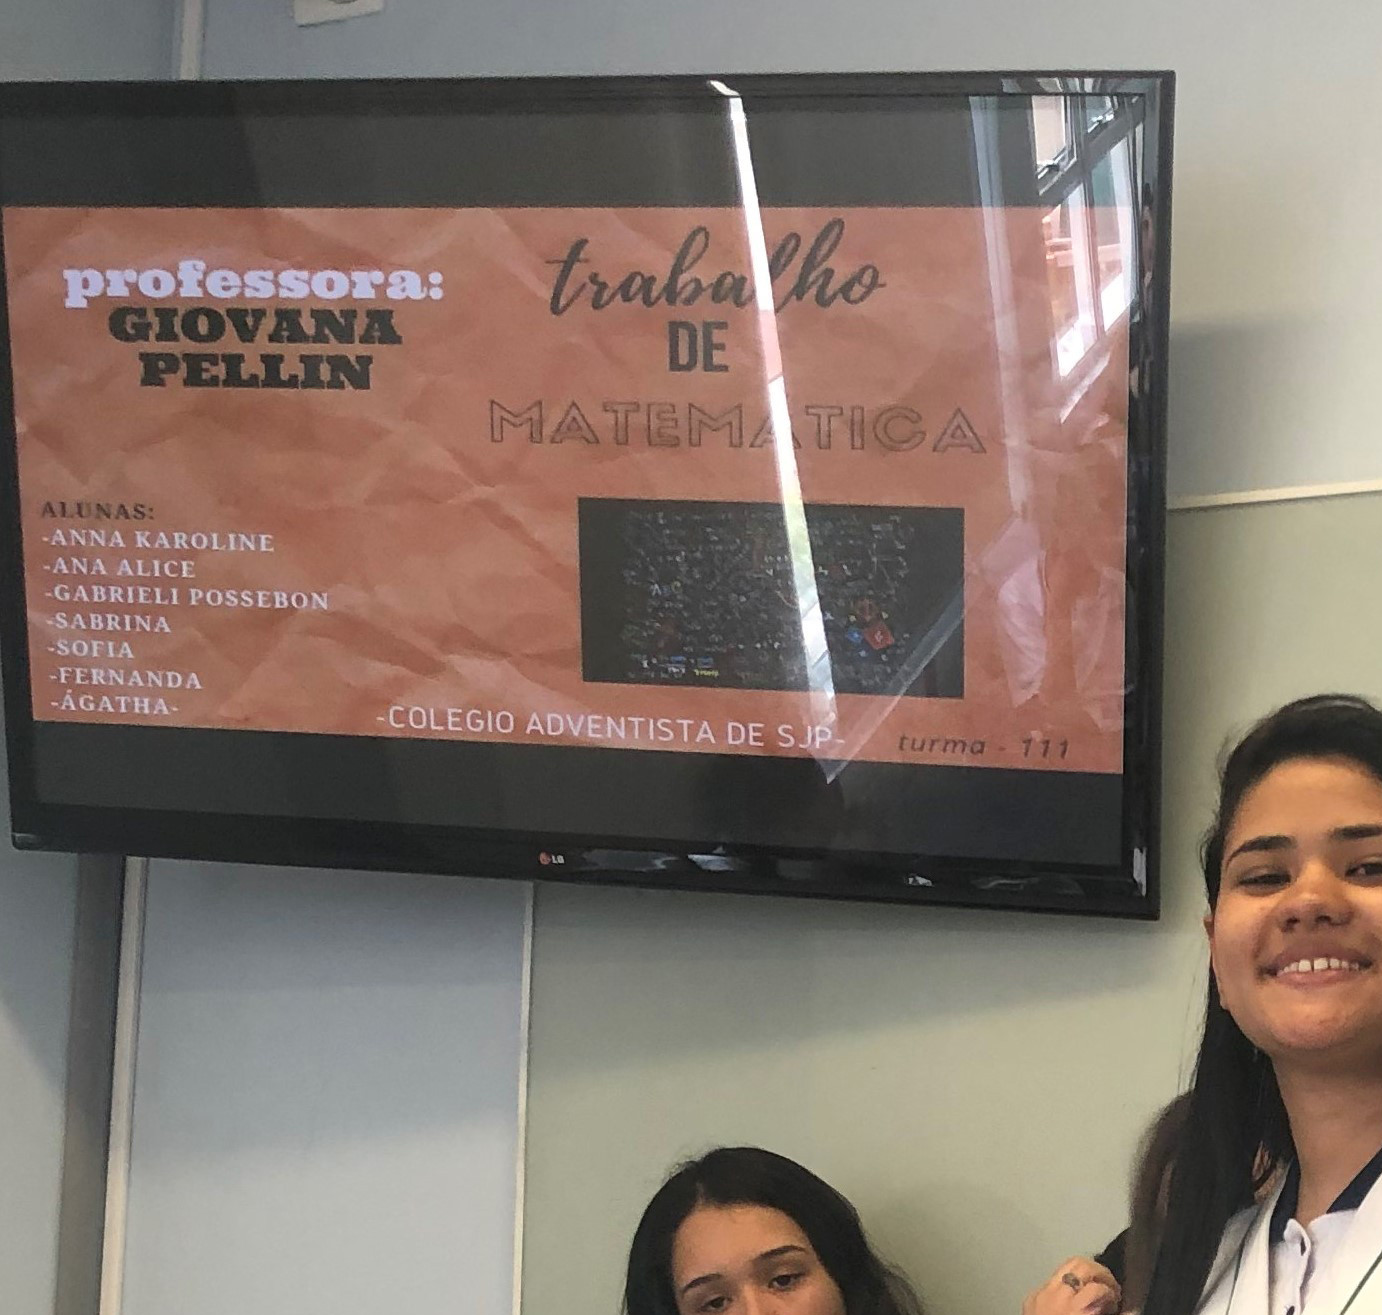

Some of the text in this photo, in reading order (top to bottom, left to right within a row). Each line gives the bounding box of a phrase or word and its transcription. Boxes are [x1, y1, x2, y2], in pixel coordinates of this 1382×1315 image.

[546, 217, 887, 316] trabalho
[63, 260, 444, 308] professora:
[107, 307, 403, 345] GIOVANA
[668, 321, 729, 373] DE
[139, 353, 373, 390] PELLIN
[41, 502, 155, 521] ALUNAS:
[42, 528, 275, 552] -ANNA KAROLINE
[43, 556, 196, 579] -ANA ALICE
[45, 584, 329, 610] -GABRIELI POSSEBON
[46, 612, 172, 634] -SABRINA
[48, 639, 134, 659] -SOFIA
[50, 666, 204, 690] -FERNANDA
[376, 705, 515, 733] -COLEGIO
[525, 712, 716, 745] ADVENTISTA
[727, 722, 766, 747] DE
[899, 734, 986, 756] turma
[1022, 738, 1069, 760] 111
[551, 854, 565, 865] LG
